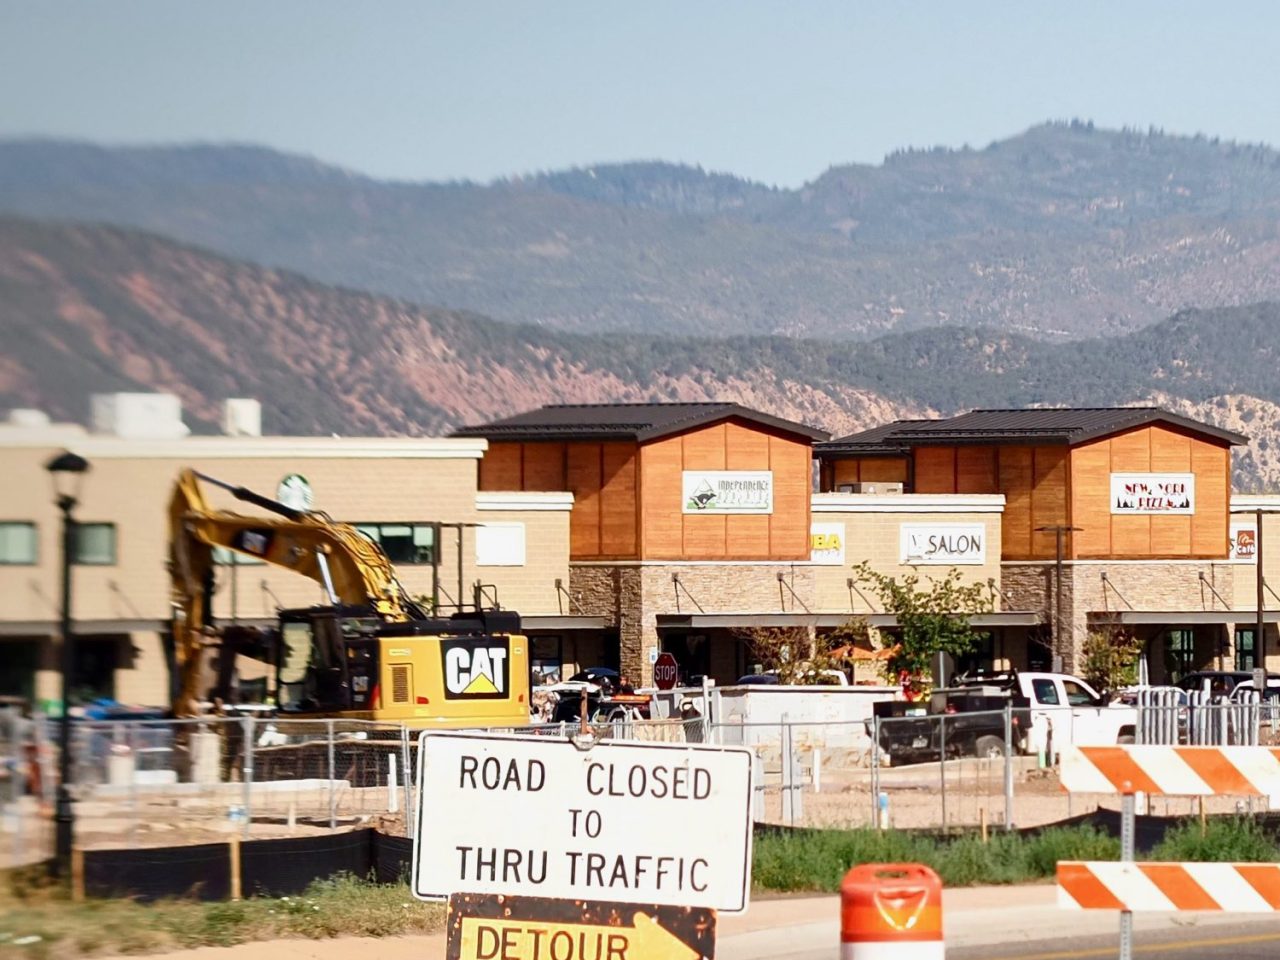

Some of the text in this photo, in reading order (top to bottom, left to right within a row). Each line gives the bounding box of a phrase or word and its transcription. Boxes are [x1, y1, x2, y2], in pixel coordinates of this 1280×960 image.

[926, 534, 981, 554] SALON
[446, 647, 507, 694] CAT
[655, 665, 676, 680] STOP
[459, 756, 712, 800] ROAD CLOSED
[568, 809, 602, 838] TO
[456, 846, 710, 892] THRU TRAFFIC
